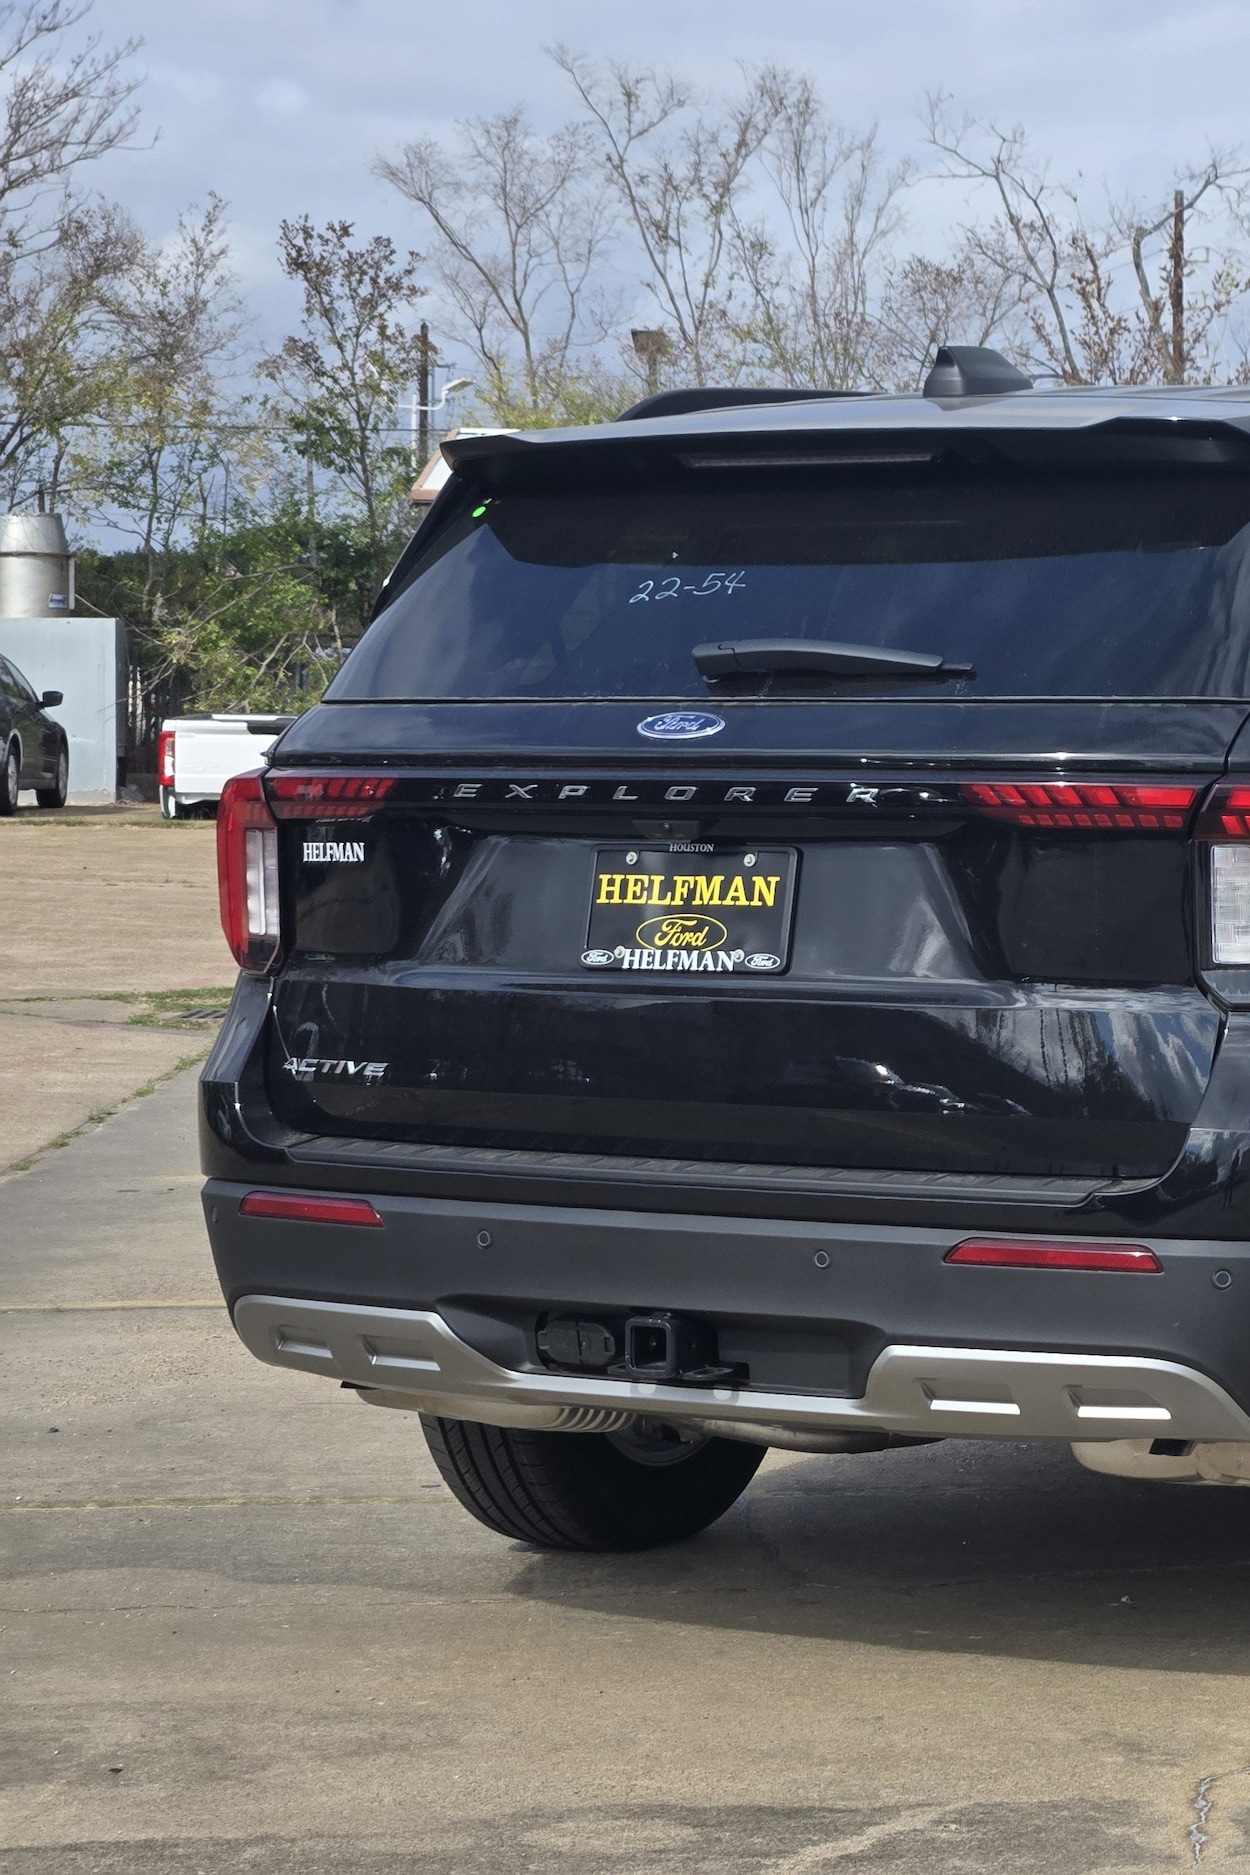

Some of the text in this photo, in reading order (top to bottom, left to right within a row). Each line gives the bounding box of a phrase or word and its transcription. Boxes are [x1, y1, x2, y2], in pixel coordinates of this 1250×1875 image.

[629, 570, 746, 603] 22-54
[452, 782, 880, 803] EXPLORER
[302, 842, 365, 862] HELFMAN
[669, 843, 714, 853] HOUSTON
[596, 874, 781, 906] HELFMAN
[654, 917, 709, 947] Ford
[621, 948, 735, 971] HELFMAN
[283, 1057, 389, 1076] ACTIVE
